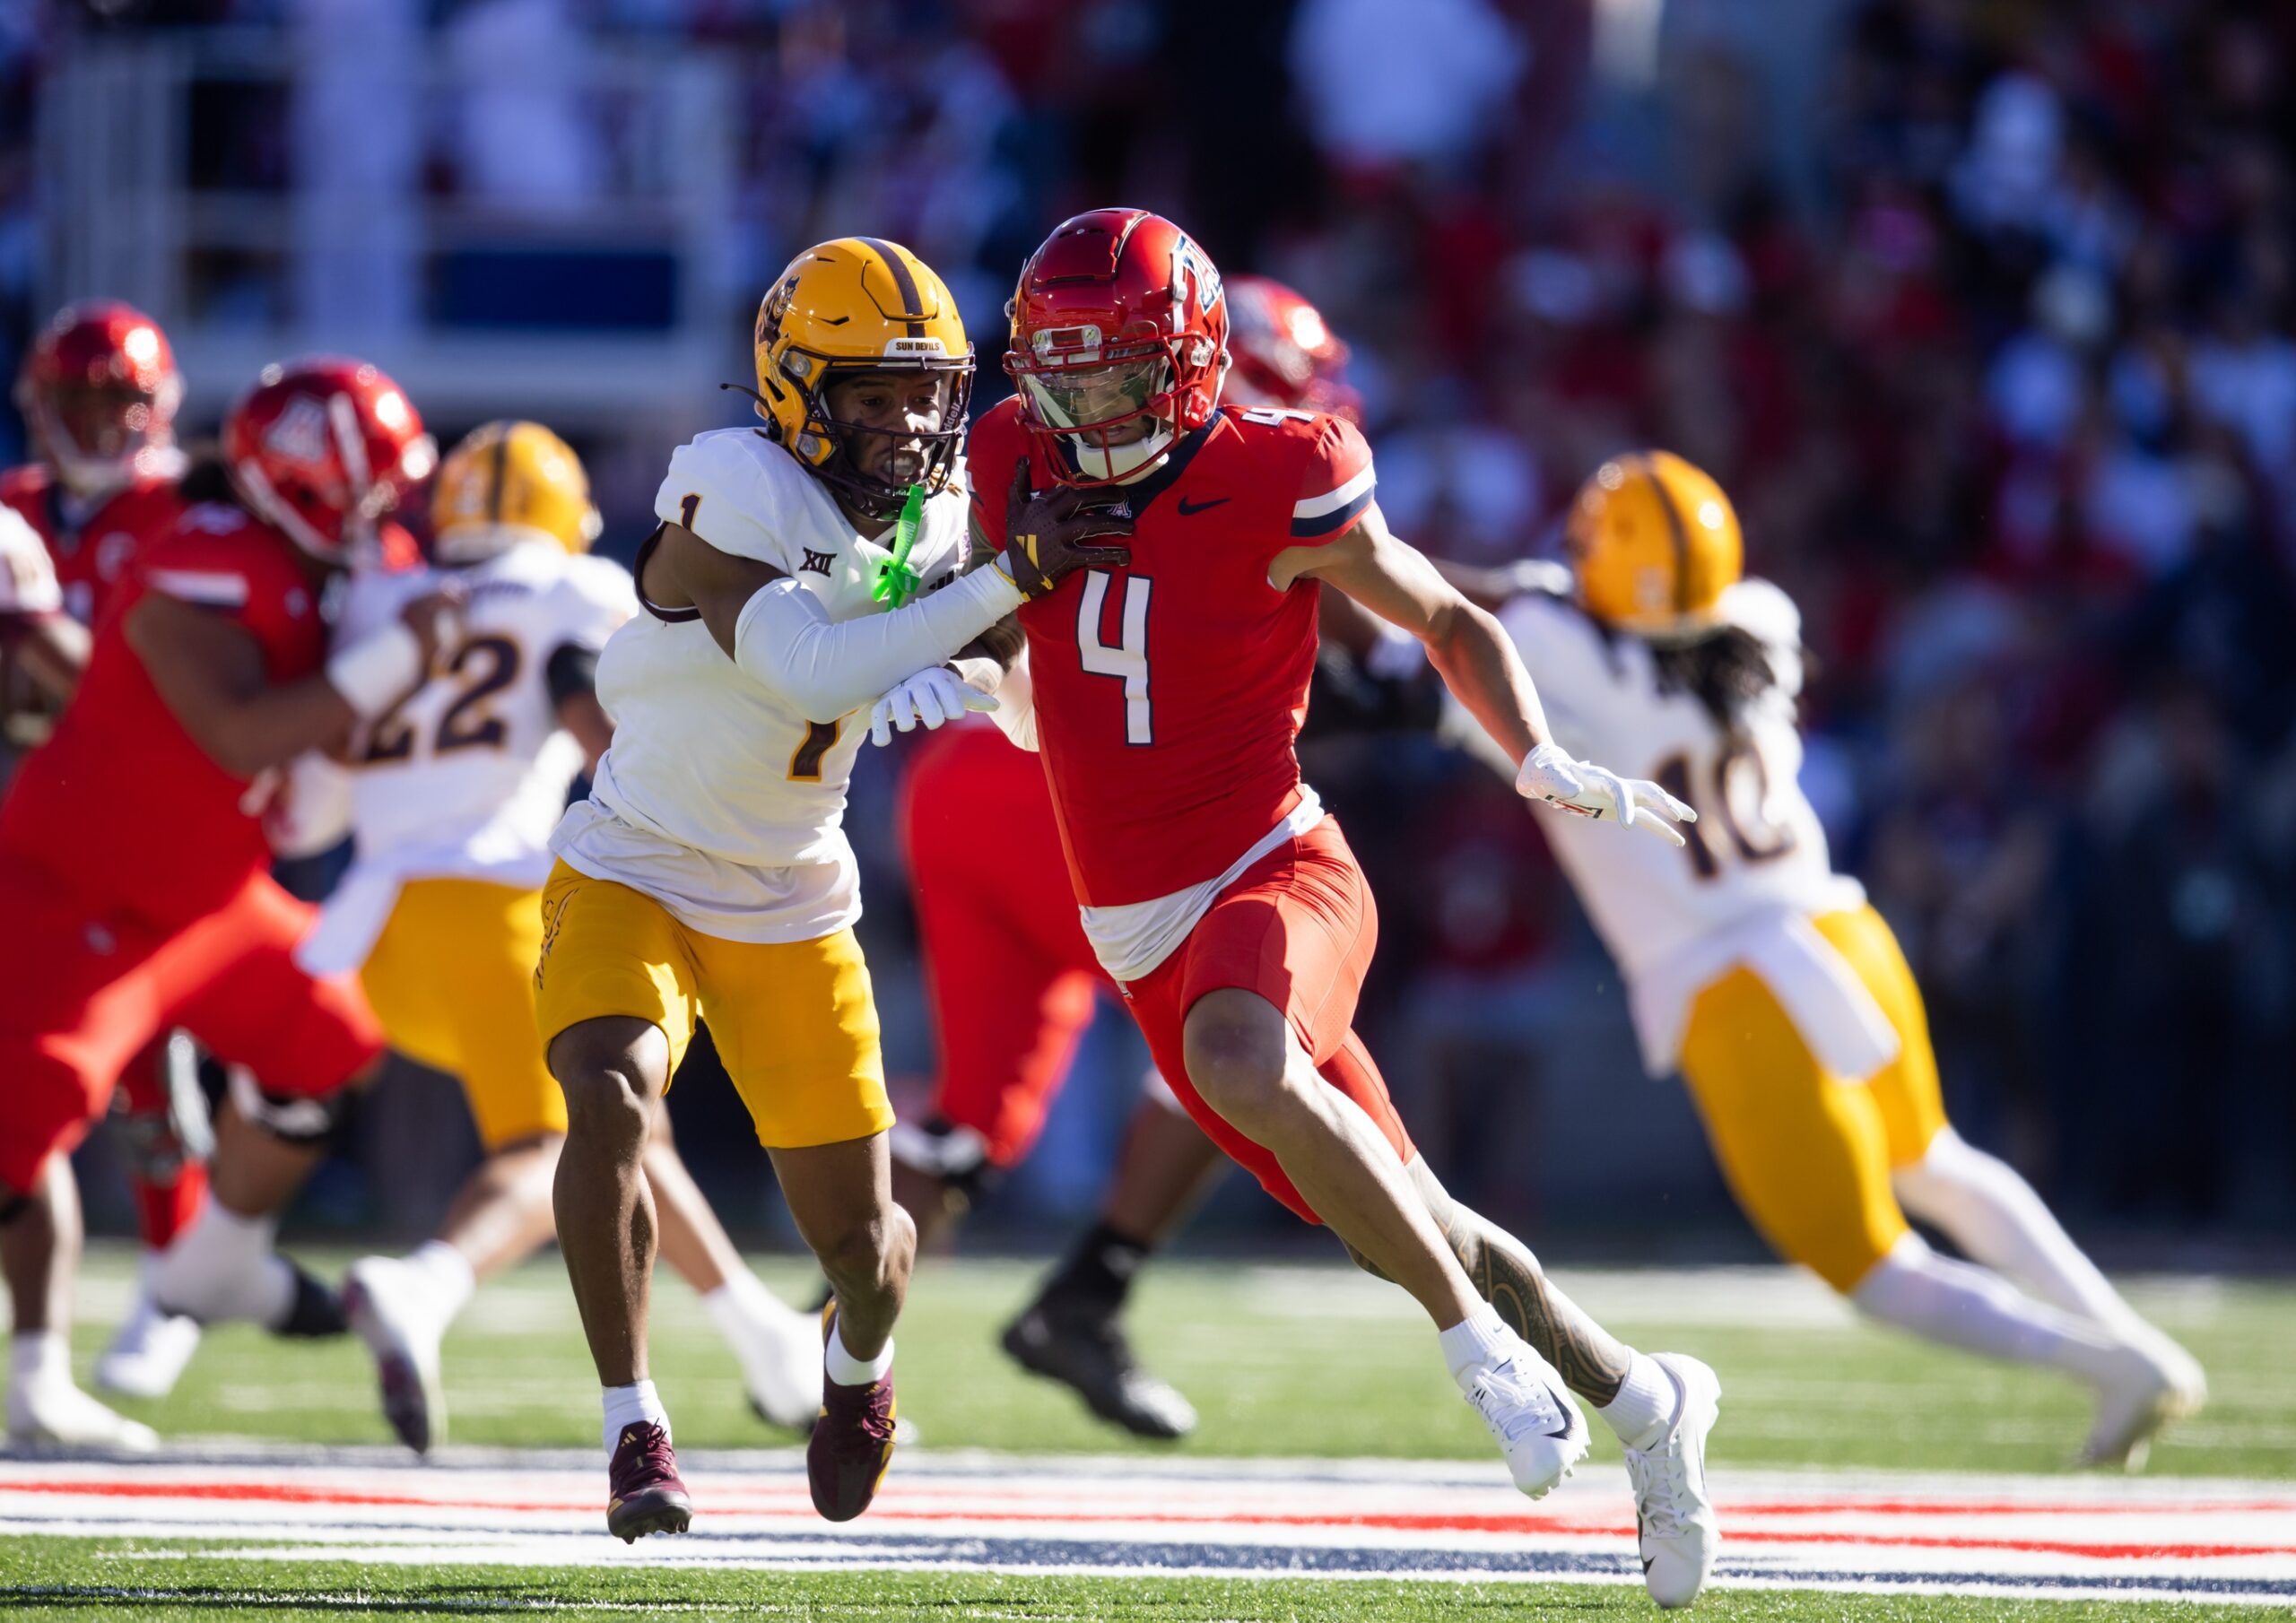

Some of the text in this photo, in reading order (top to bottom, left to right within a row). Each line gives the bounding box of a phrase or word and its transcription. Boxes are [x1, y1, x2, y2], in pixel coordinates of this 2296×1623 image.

[895, 342, 940, 352] SUN DEVILS
[1239, 406, 1317, 429] 4
[679, 491, 704, 532] 1
[798, 546, 839, 578] XII
[1075, 568, 1154, 747] 4
